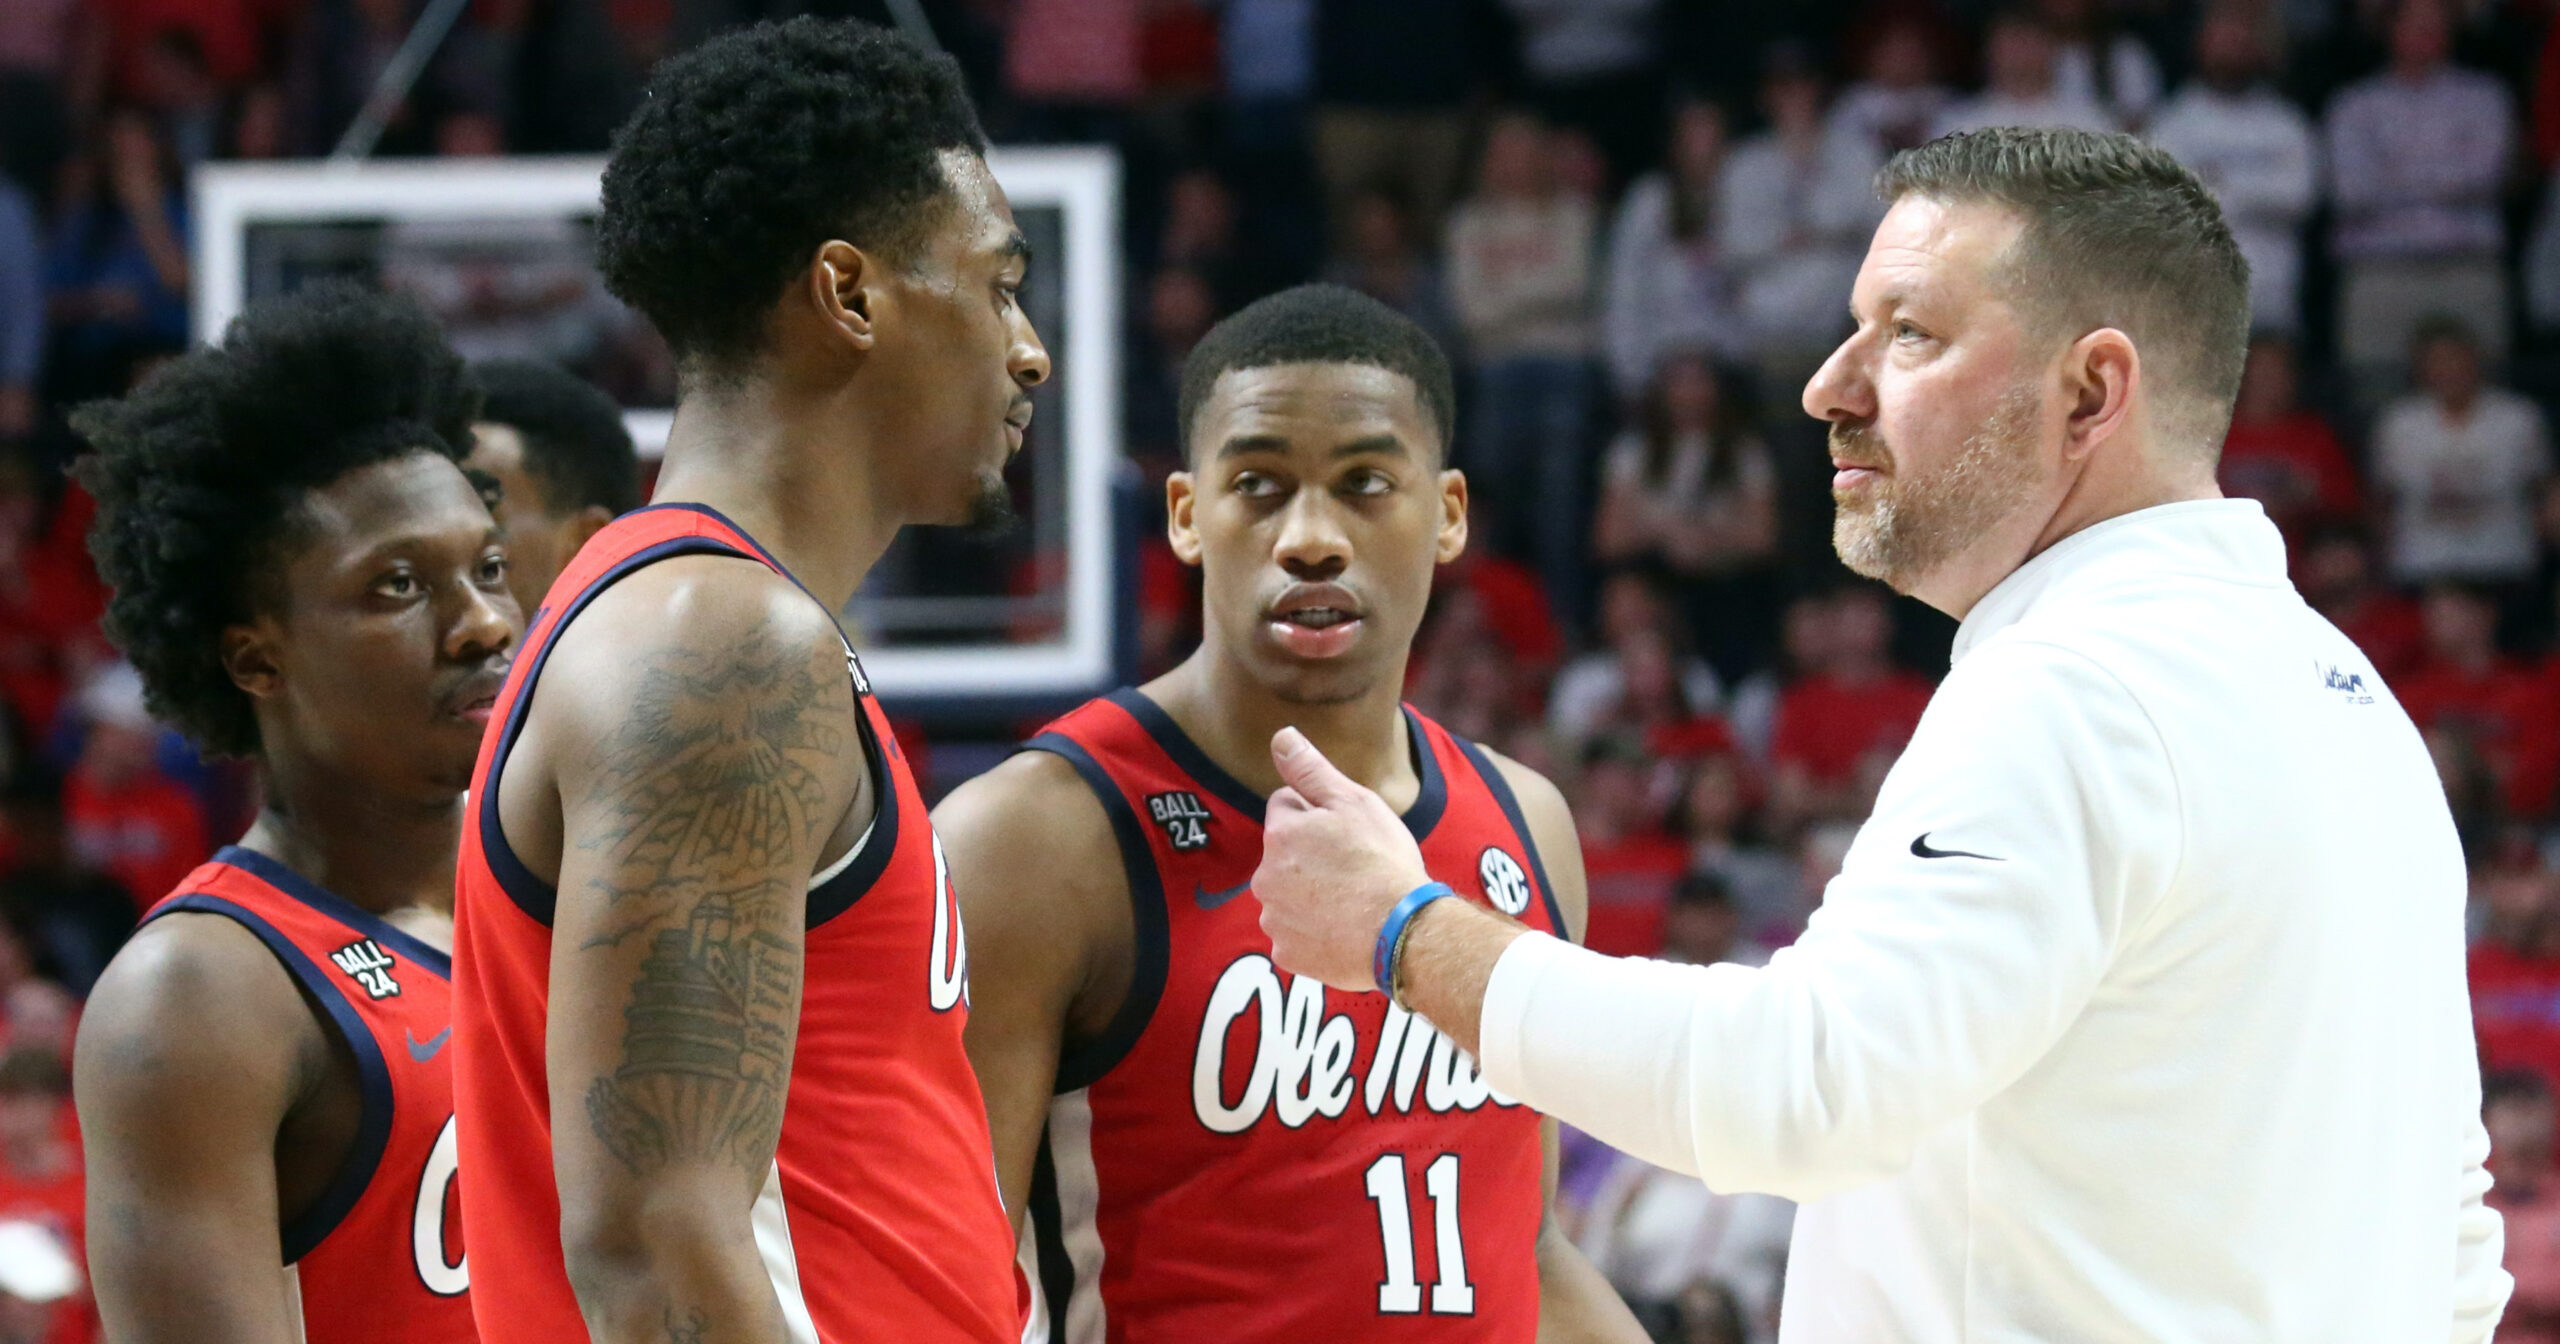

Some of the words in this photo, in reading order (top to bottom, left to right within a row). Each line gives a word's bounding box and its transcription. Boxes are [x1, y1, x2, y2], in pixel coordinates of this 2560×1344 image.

[1150, 793, 1209, 821] BALL
[1168, 818, 1208, 847] 24
[1480, 846, 1530, 914] SEC
[331, 939, 394, 975] BALL
[357, 966, 399, 996] 24
[1193, 953, 1356, 1134] Ole
[1363, 1152, 1475, 1316] 11
